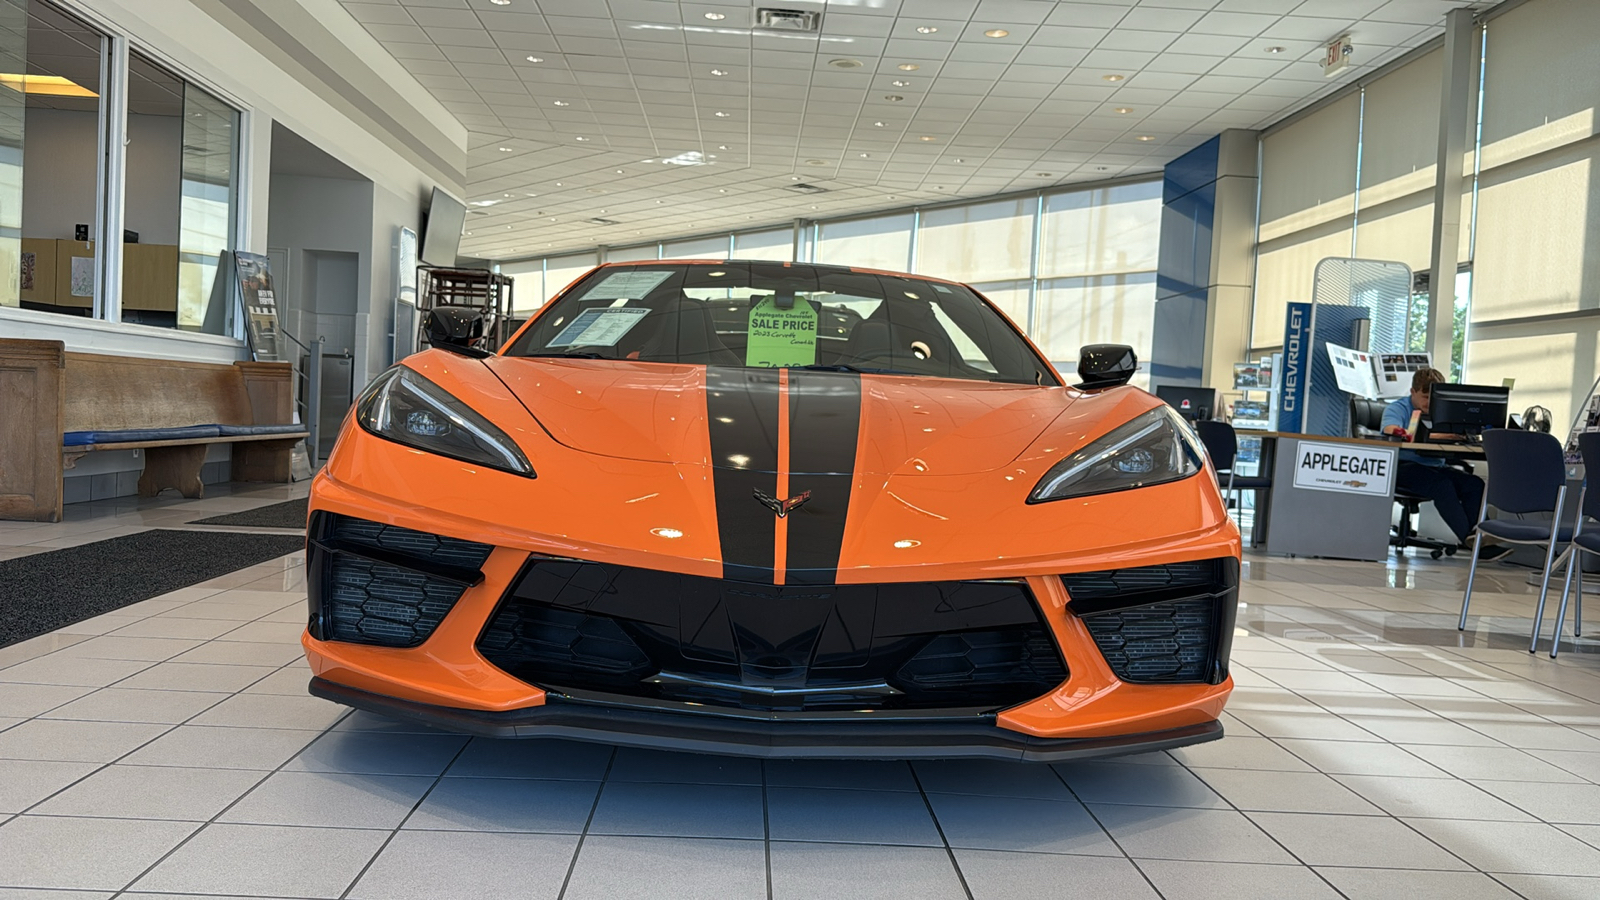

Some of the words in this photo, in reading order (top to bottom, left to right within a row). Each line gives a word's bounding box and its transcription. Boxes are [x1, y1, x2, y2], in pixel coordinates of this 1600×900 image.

[1328, 41, 1341, 66] EXIT
[751, 319, 780, 329] SALE
[782, 320, 815, 331] PRICE
[1283, 307, 1302, 412] CHEVROLET
[1301, 452, 1387, 477] APPLEGATE
